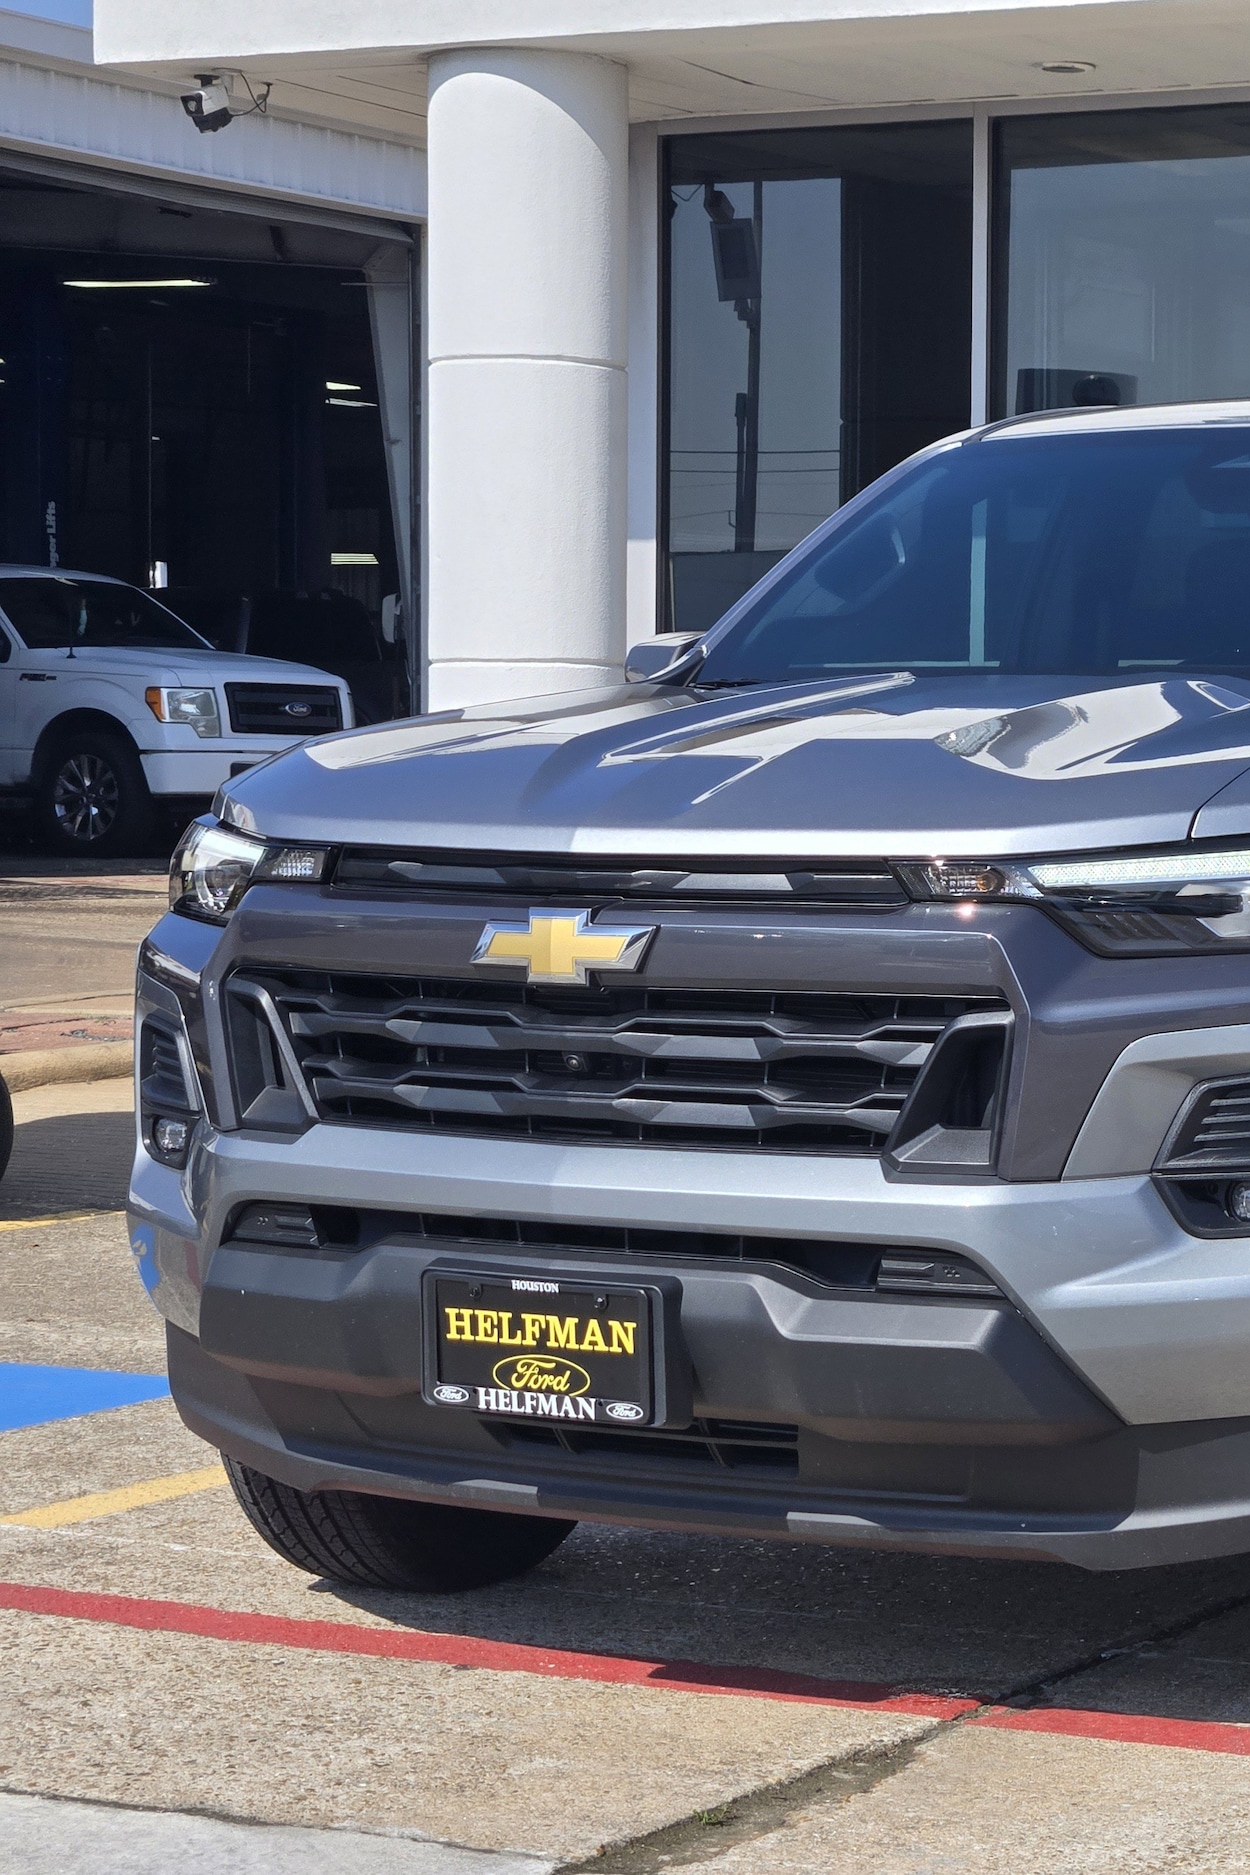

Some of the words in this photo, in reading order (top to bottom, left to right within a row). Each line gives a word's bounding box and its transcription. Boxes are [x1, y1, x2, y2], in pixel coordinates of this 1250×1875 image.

[511, 1280, 559, 1293] HOUSTON
[444, 1307, 637, 1355] HELFMAN
[510, 1359, 571, 1392] Ford
[440, 1387, 463, 1400] Ford
[475, 1387, 597, 1420] HELFMAN
[612, 1404, 637, 1418] Ford
